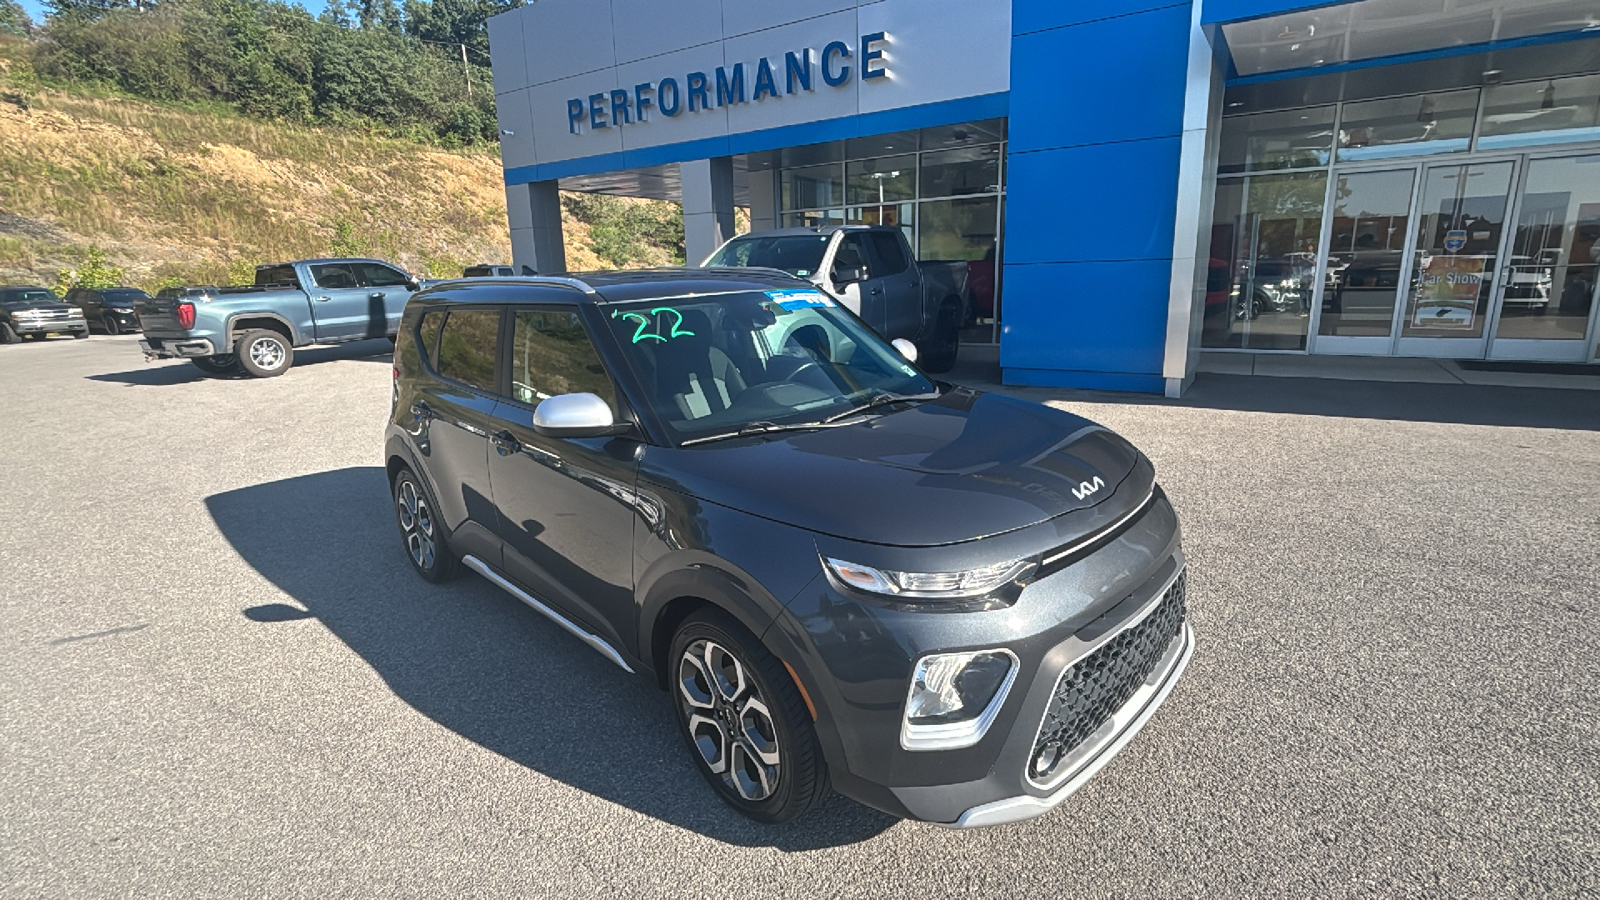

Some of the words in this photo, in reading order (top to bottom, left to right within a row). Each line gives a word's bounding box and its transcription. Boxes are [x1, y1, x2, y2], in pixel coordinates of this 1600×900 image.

[567, 31, 894, 135] PERFORMANCE
[1422, 273, 1441, 284] Car
[1446, 271, 1479, 284] Show
[1071, 475, 1105, 500] KIA
